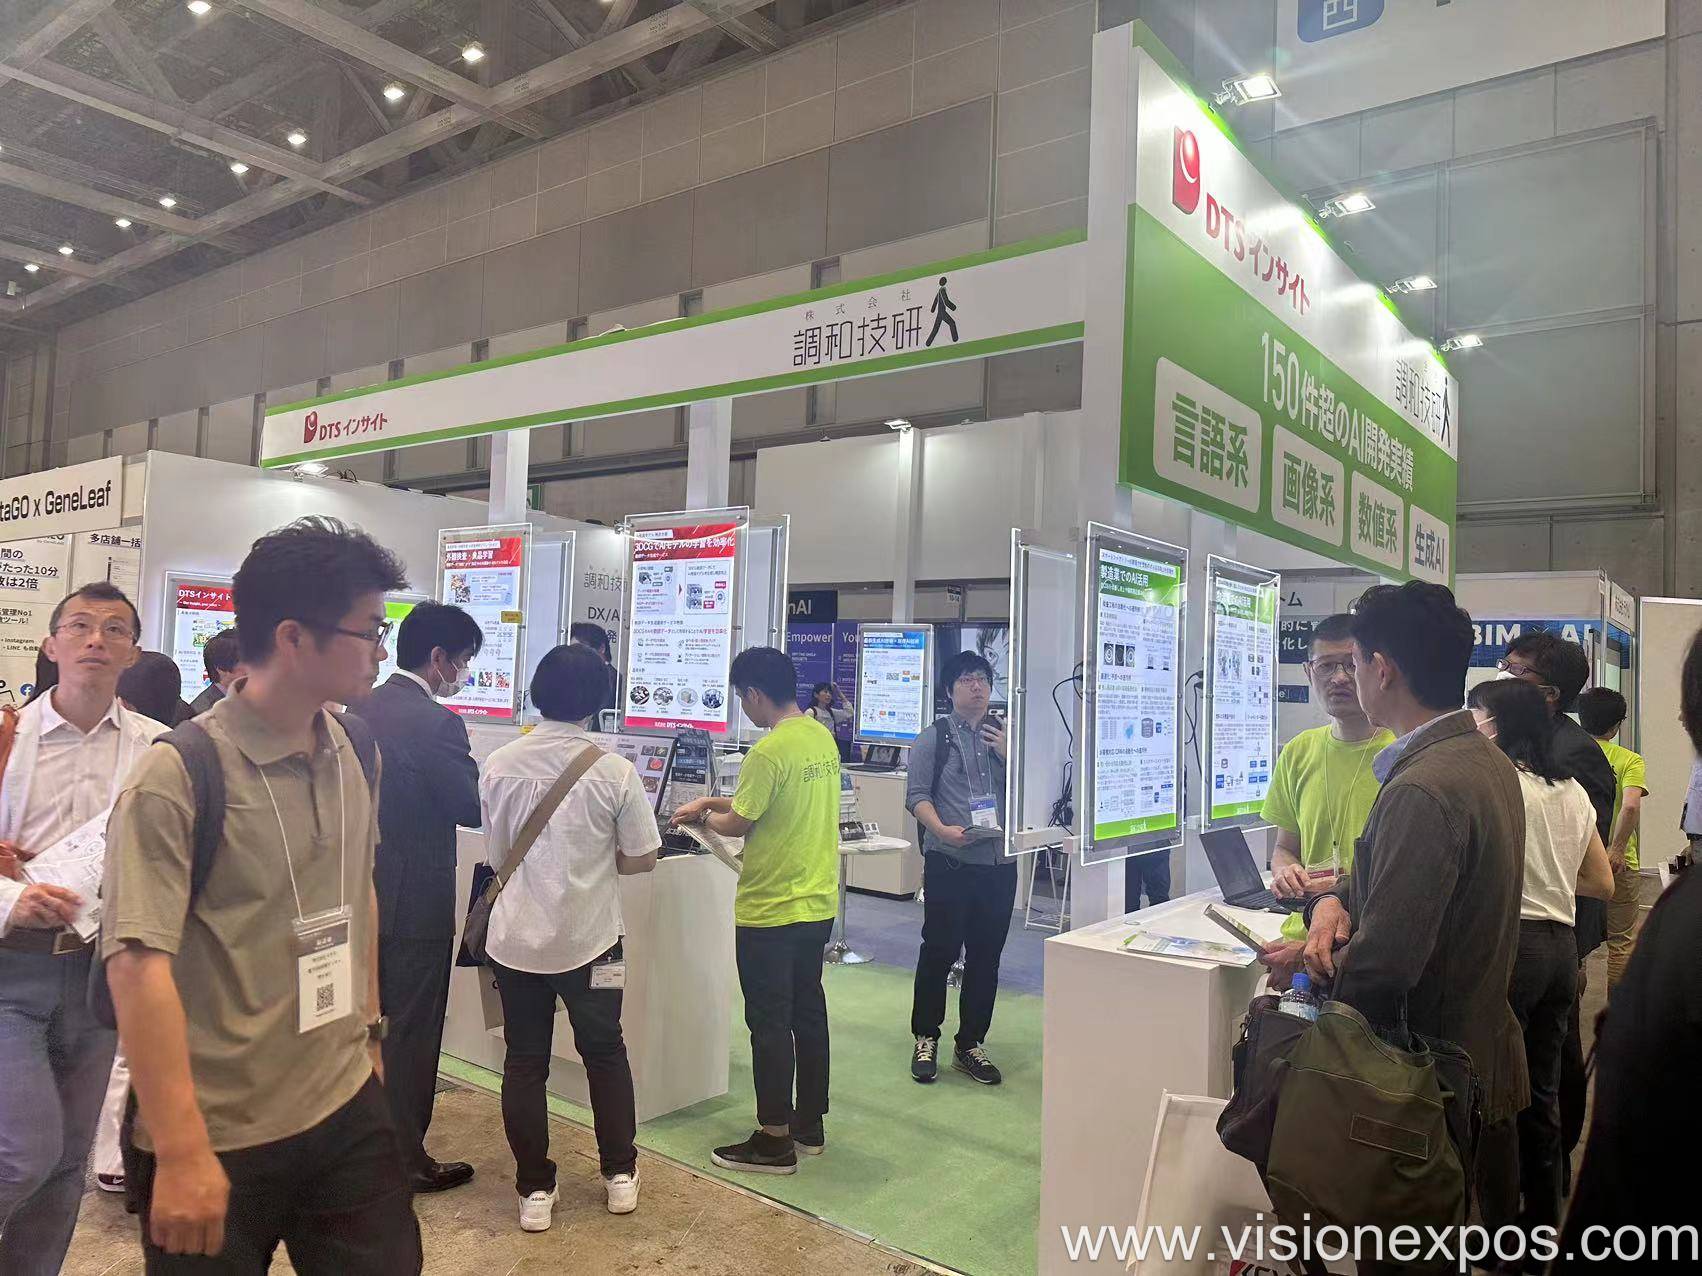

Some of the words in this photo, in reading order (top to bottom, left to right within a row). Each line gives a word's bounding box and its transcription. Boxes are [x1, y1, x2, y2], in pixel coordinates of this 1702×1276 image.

[1206, 192, 1311, 316] DTSインサイト
[805, 289, 911, 321] 株式会社
[793, 306, 923, 366] 調和技研
[1261, 331, 1415, 493] 150件超のAI開発実績
[1394, 357, 1441, 438] 調和技研
[319, 412, 388, 441] DTSインサイト
[1171, 391, 1249, 489] 言語系
[32, 498, 41, 517] x
[45, 479, 111, 515] GeneLeaf
[1282, 451, 1336, 528] 画像系
[1358, 492, 1398, 554] 数値系
[1414, 523, 1446, 575] 生成AI
[0, 561, 59, 577] たった10分
[179, 589, 231, 601] DTSインサイト
[1473, 624, 1521, 646] BIM
